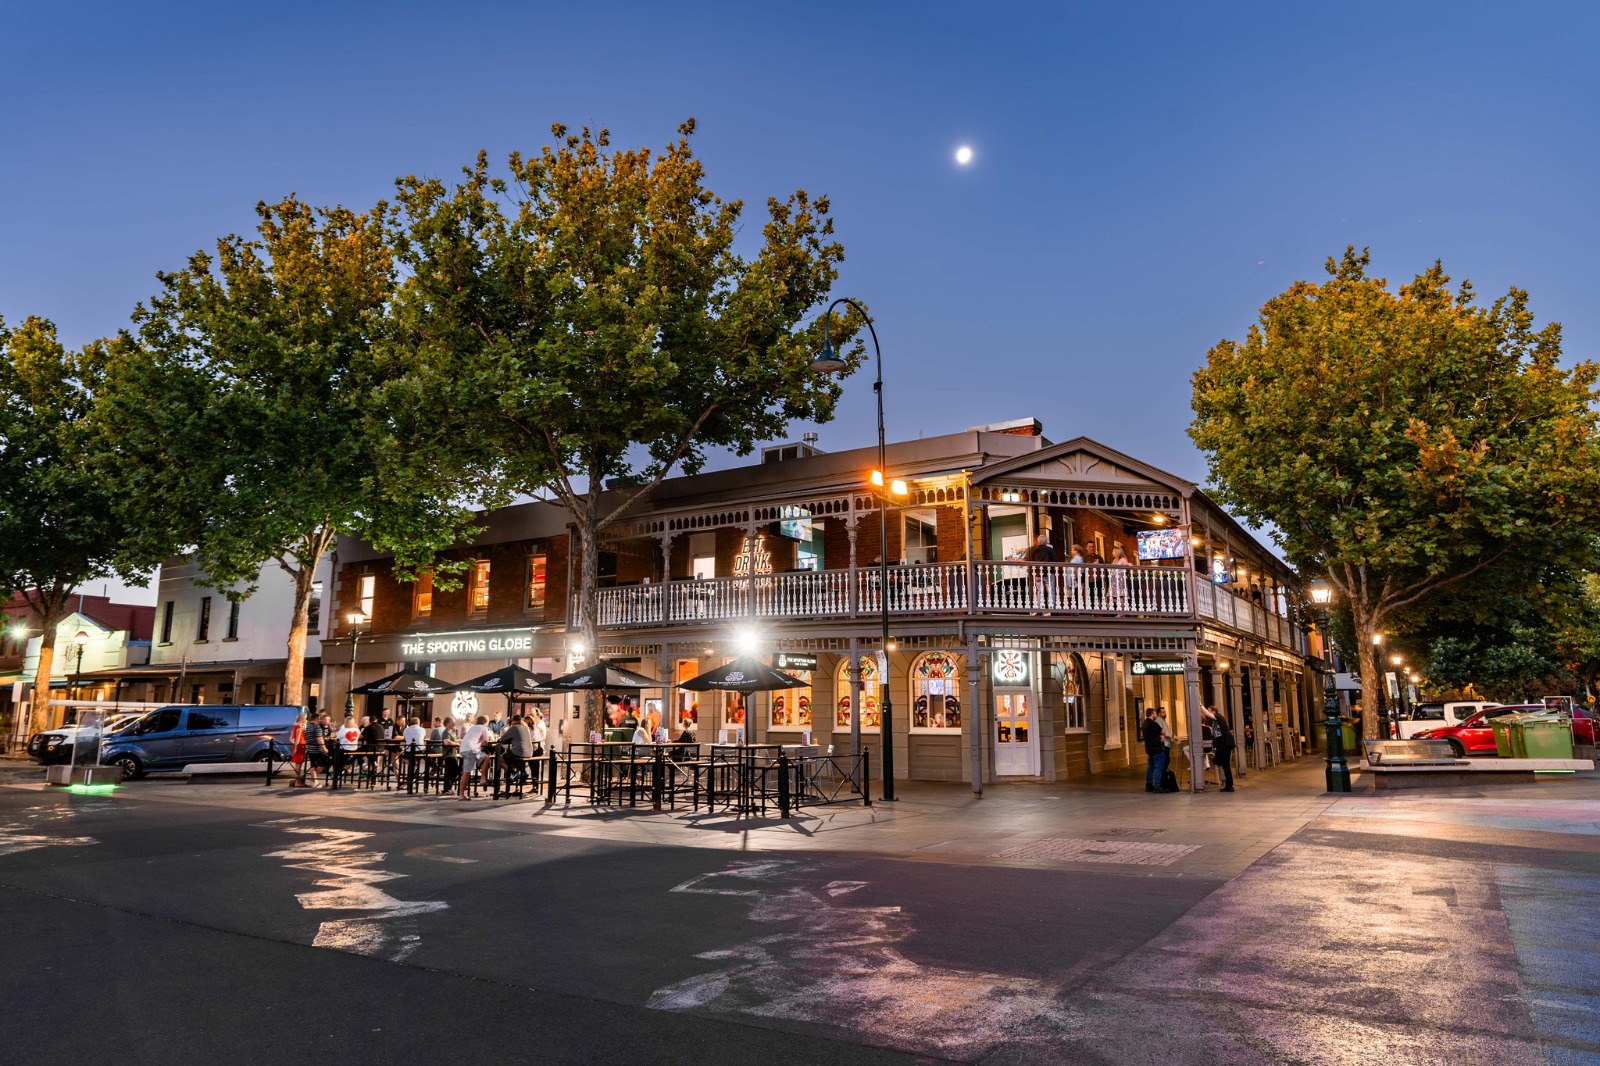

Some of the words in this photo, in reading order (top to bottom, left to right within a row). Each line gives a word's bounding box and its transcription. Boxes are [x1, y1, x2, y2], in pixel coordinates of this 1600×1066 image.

[742, 536, 764, 554] ET.
[734, 553, 772, 571] DRNK.
[402, 643, 424, 655] THE
[426, 640, 486, 654] SPORTING
[488, 638, 532, 651] GLOBE
